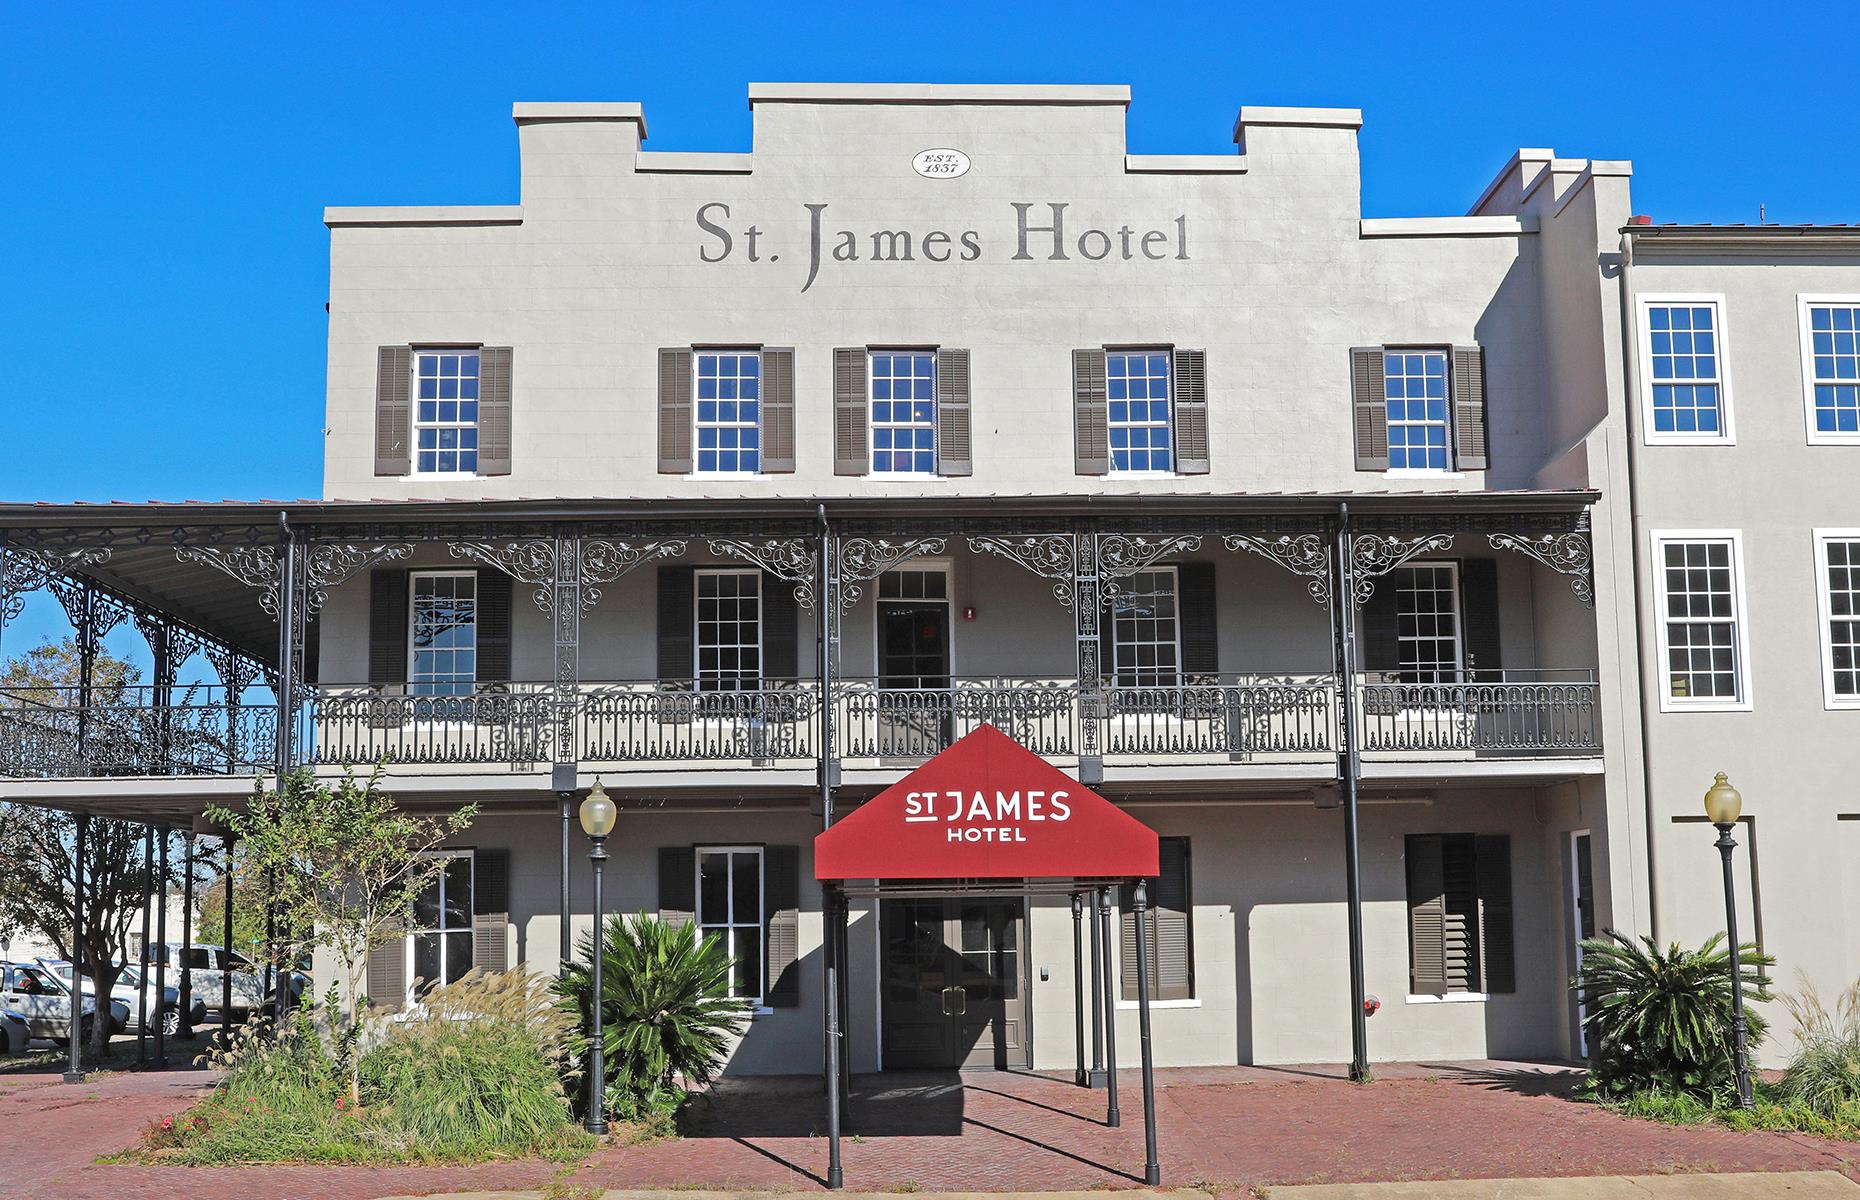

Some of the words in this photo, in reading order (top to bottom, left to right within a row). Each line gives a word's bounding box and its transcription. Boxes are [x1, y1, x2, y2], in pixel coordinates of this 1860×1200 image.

[923, 154, 959, 163] EST.
[923, 163, 958, 173] 1837
[696, 202, 780, 263] St.
[800, 203, 981, 294] James
[1011, 202, 1191, 261] Hotel
[905, 792, 938, 816] ST
[946, 791, 1071, 821] JAMES
[947, 828, 1027, 842] HOTEL
